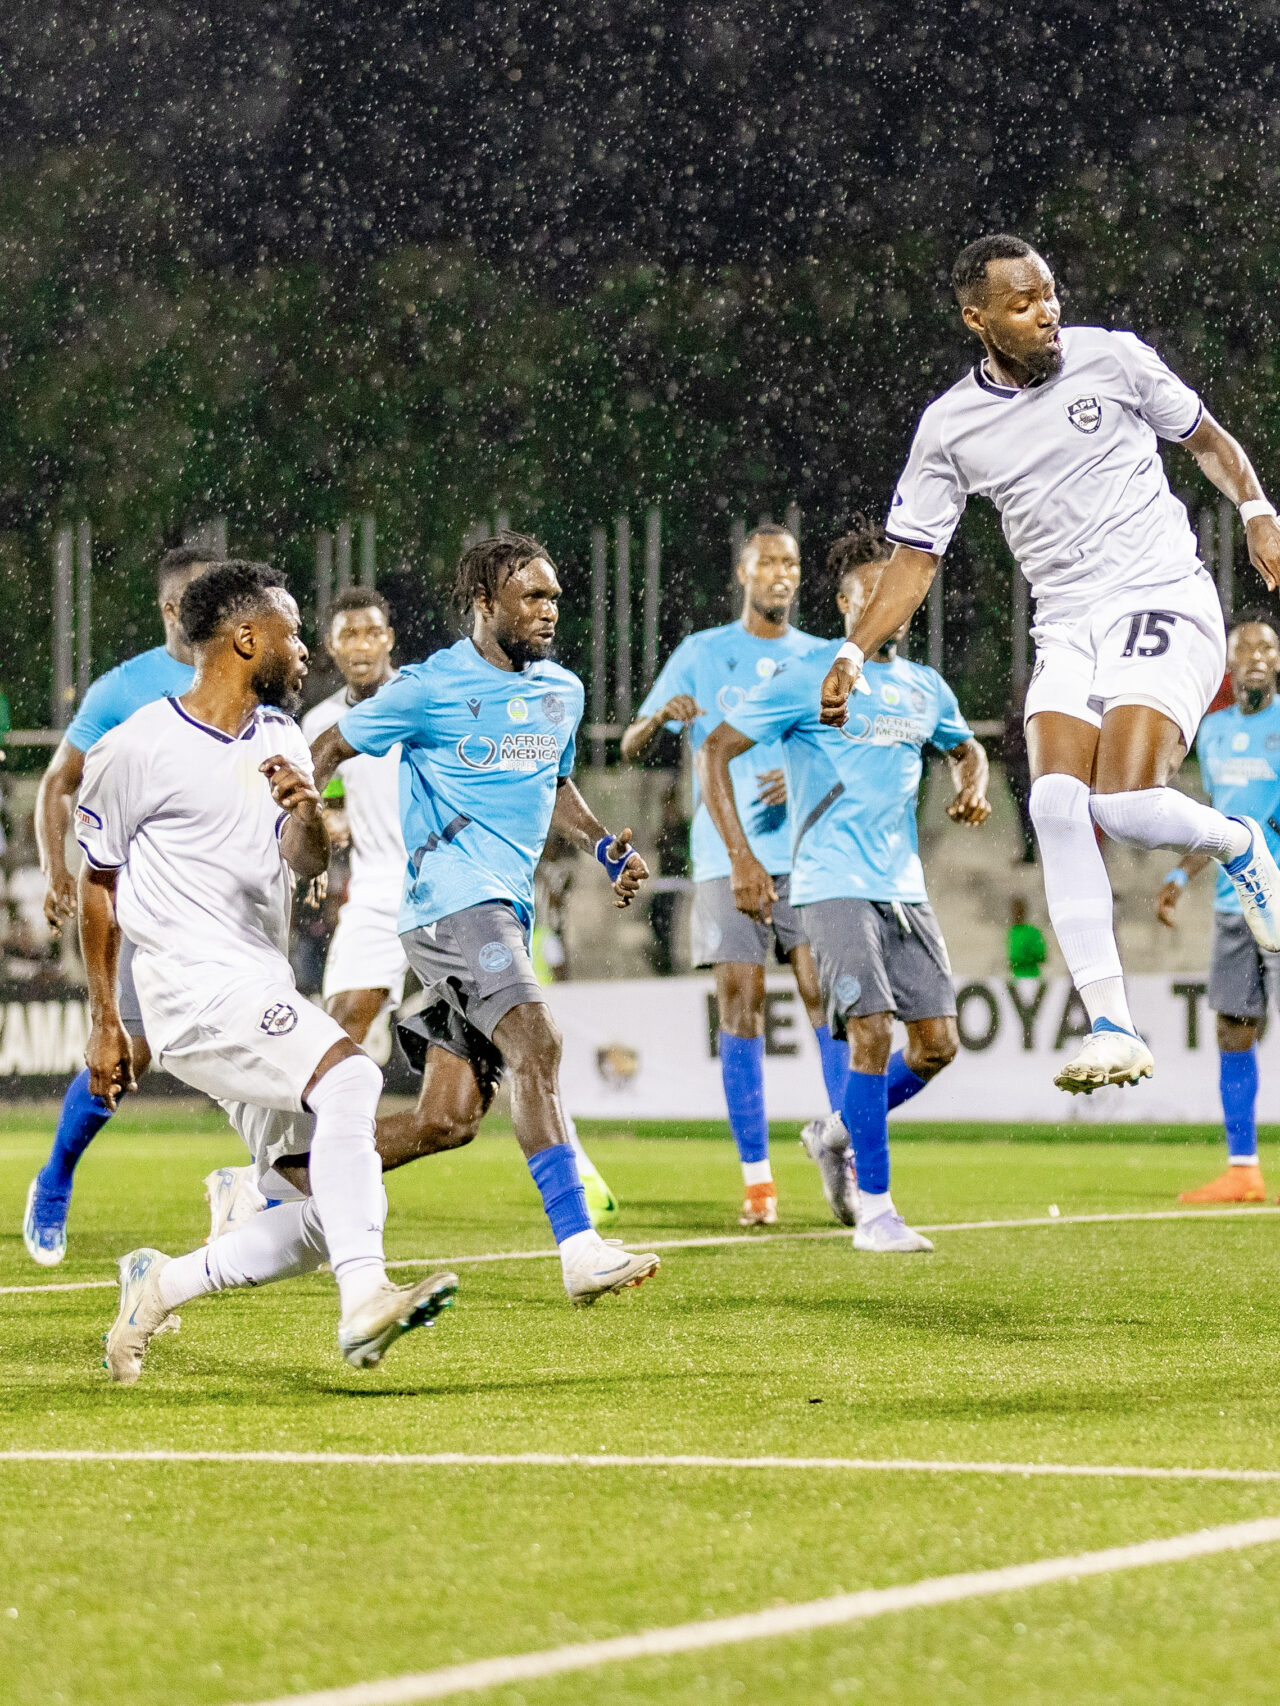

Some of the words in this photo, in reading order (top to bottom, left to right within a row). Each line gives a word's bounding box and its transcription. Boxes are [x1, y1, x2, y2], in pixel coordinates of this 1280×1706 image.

[1072, 400, 1094, 411] APR
[1120, 612, 1177, 658] 15
[876, 715, 921, 730] AFRIC
[502, 735, 557, 746] AFRICA
[955, 982, 1149, 1050] OYA
